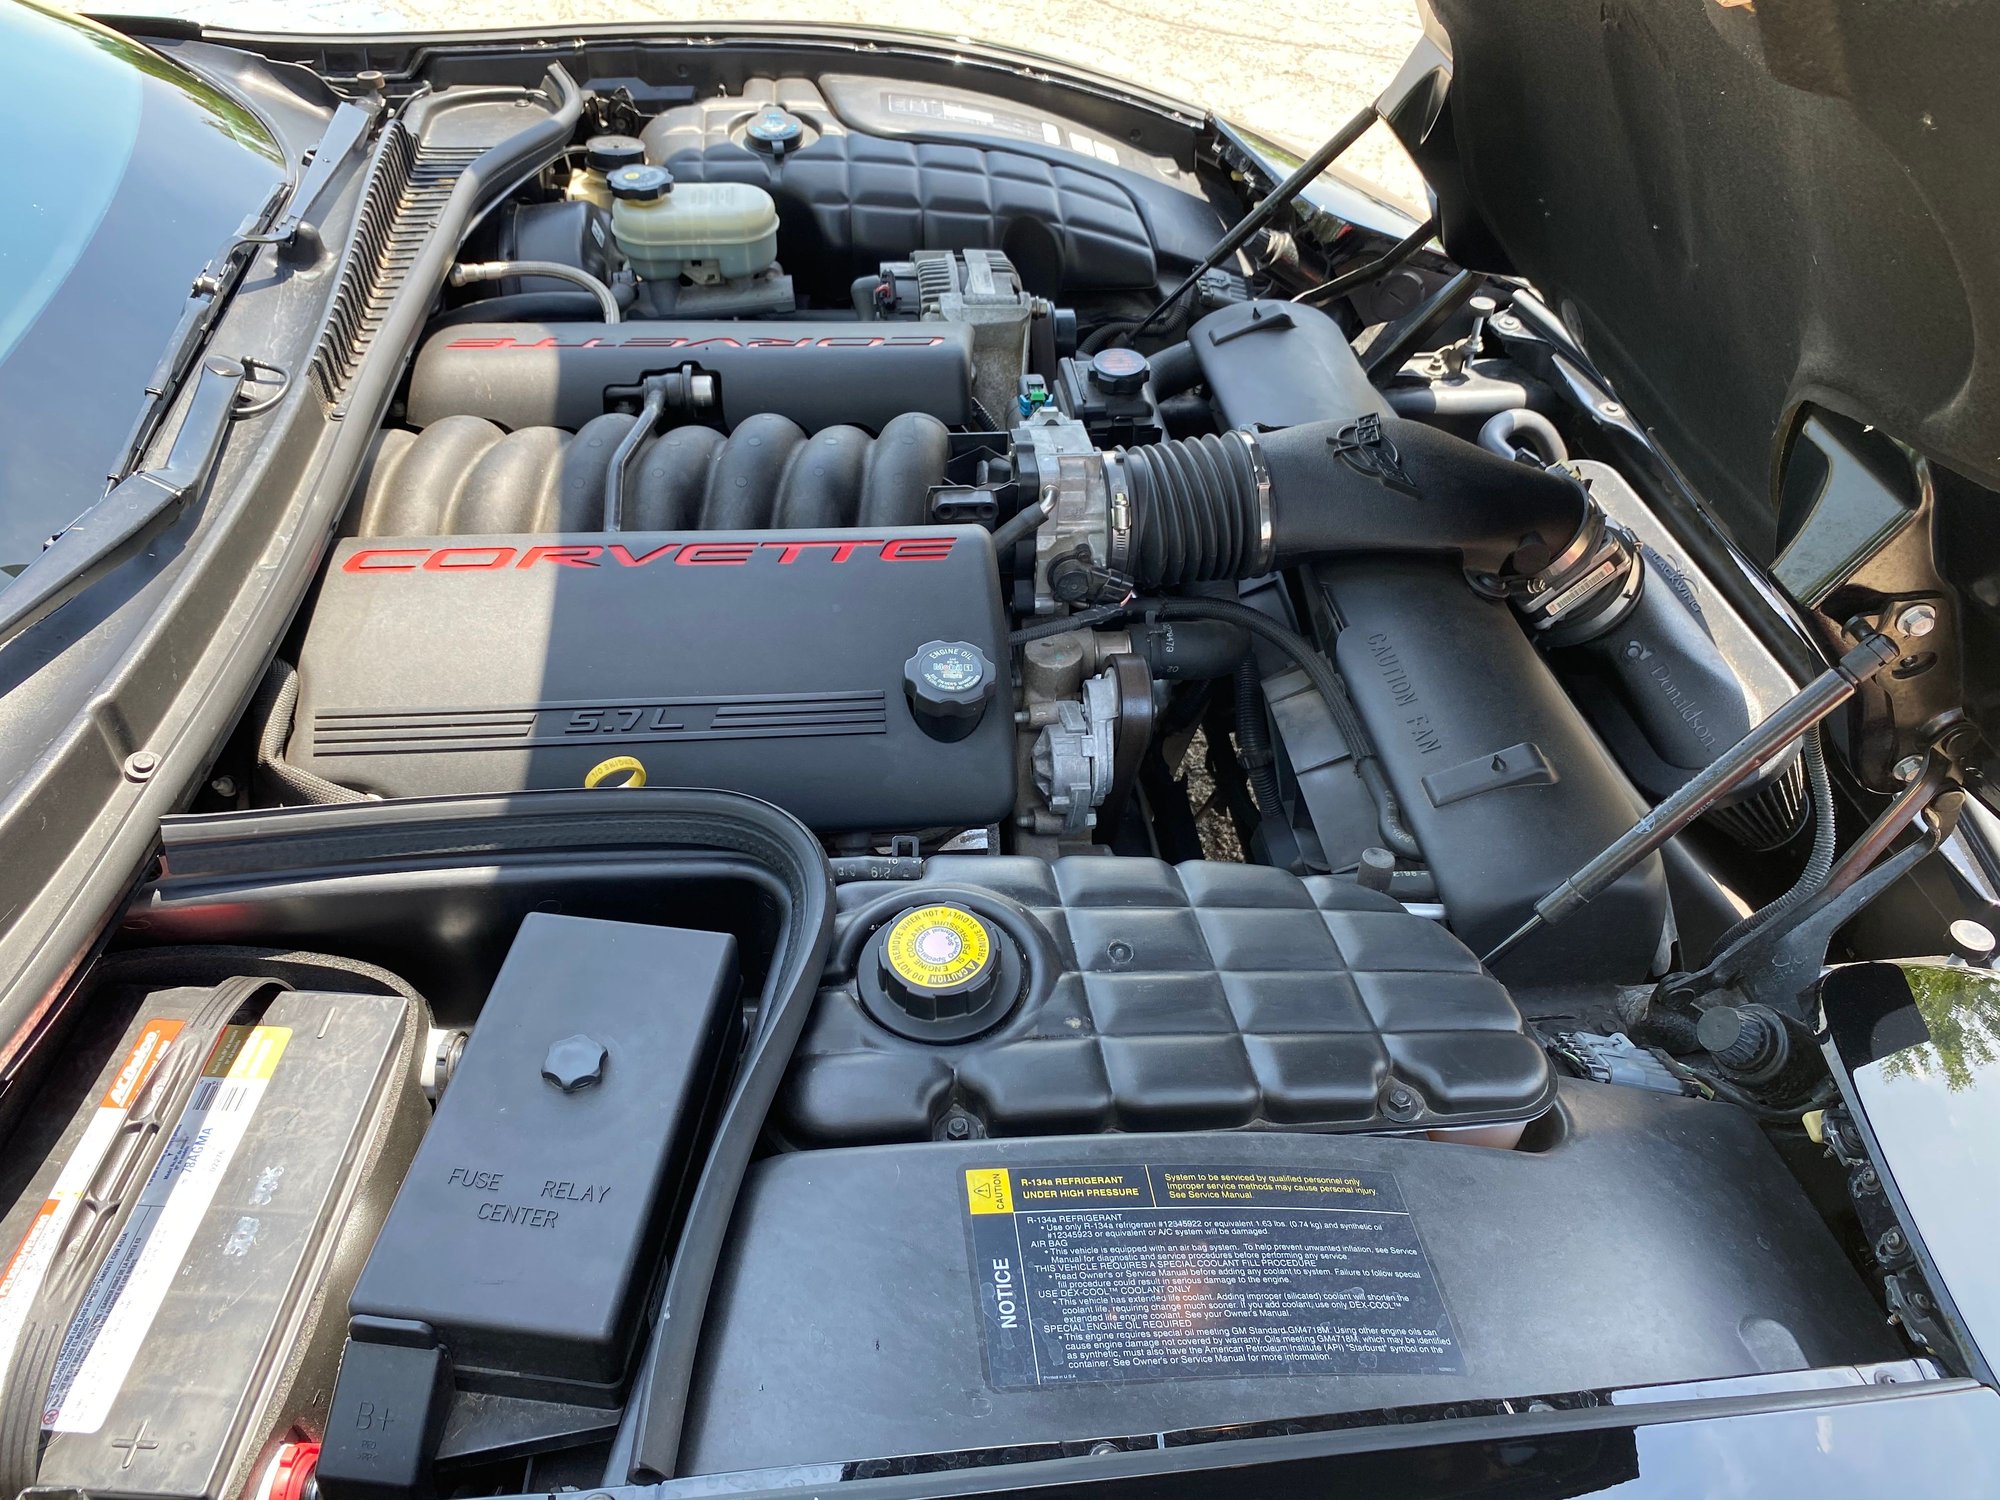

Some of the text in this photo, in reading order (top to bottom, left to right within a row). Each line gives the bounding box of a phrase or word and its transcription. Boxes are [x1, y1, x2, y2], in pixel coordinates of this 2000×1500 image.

[342, 536, 958, 572] CORVETTE
[929, 649, 958, 659] ENGINE
[961, 651, 973, 660] OIL
[1368, 634, 1442, 754] CAUTION FAN
[1651, 662, 1715, 748] Donaldson
[565, 708, 684, 734] 5.7L
[900, 915, 920, 931] WHEN
[932, 921, 969, 942] PRESSURE
[892, 931, 903, 960] REMOVE
[906, 924, 949, 972] ENGINE COOLANT
[897, 961, 913, 974] NOT
[912, 972, 924, 981] DO
[932, 969, 968, 983] CAUTION
[448, 1168, 611, 1204] FUSE RELAY
[1021, 1176, 1123, 1187] R-134a REFRIGERANT
[1164, 1173, 1196, 1182] System
[1257, 1174, 1267, 1183] by
[1268, 1174, 1302, 1183] qualified
[1303, 1177, 1343, 1185] personnel
[1344, 1178, 1363, 1187] only.
[992, 1174, 1004, 1210] CAUTION
[1023, 1188, 1139, 1199] UNDER HIGH PRESSURE
[1166, 1182, 1205, 1191] Improper
[1274, 1184, 1292, 1193] may
[1320, 1186, 1355, 1194] personal
[1356, 1186, 1378, 1196] injury.
[477, 1202, 559, 1228] CENTER
[1026, 1213, 1123, 1224] R-134a REFRIGERANT
[1058, 1263, 1098, 1272] VEHICLE
[1100, 1261, 1148, 1270] REQUIRES
[1199, 1259, 1239, 1267] COOLANT
[1069, 1280, 1112, 1290] procedure
[1113, 1279, 1136, 1287] could
[1138, 1278, 1160, 1286] result
[1203, 1276, 1236, 1285] damage
[1262, 1276, 1292, 1285] engine.
[999, 1258, 1018, 1329] NOTICE
[1038, 1290, 1058, 1298] USE
[1120, 1287, 1165, 1295] COOLANT
[1063, 1314, 1103, 1323] extended
[1119, 1313, 1148, 1322] engine
[1150, 1311, 1183, 1320] coolant.
[1203, 1312, 1222, 1320] your
[1043, 1324, 1085, 1334] SPECIAL
[1086, 1322, 1123, 1331] ENGINE
[1142, 1320, 1192, 1329] REQUIRED
[1068, 1360, 1110, 1369] container.
[1132, 1357, 1168, 1366] Owner's
[1214, 1354, 1246, 1363] Manual
[1284, 1353, 1333, 1361] information.
